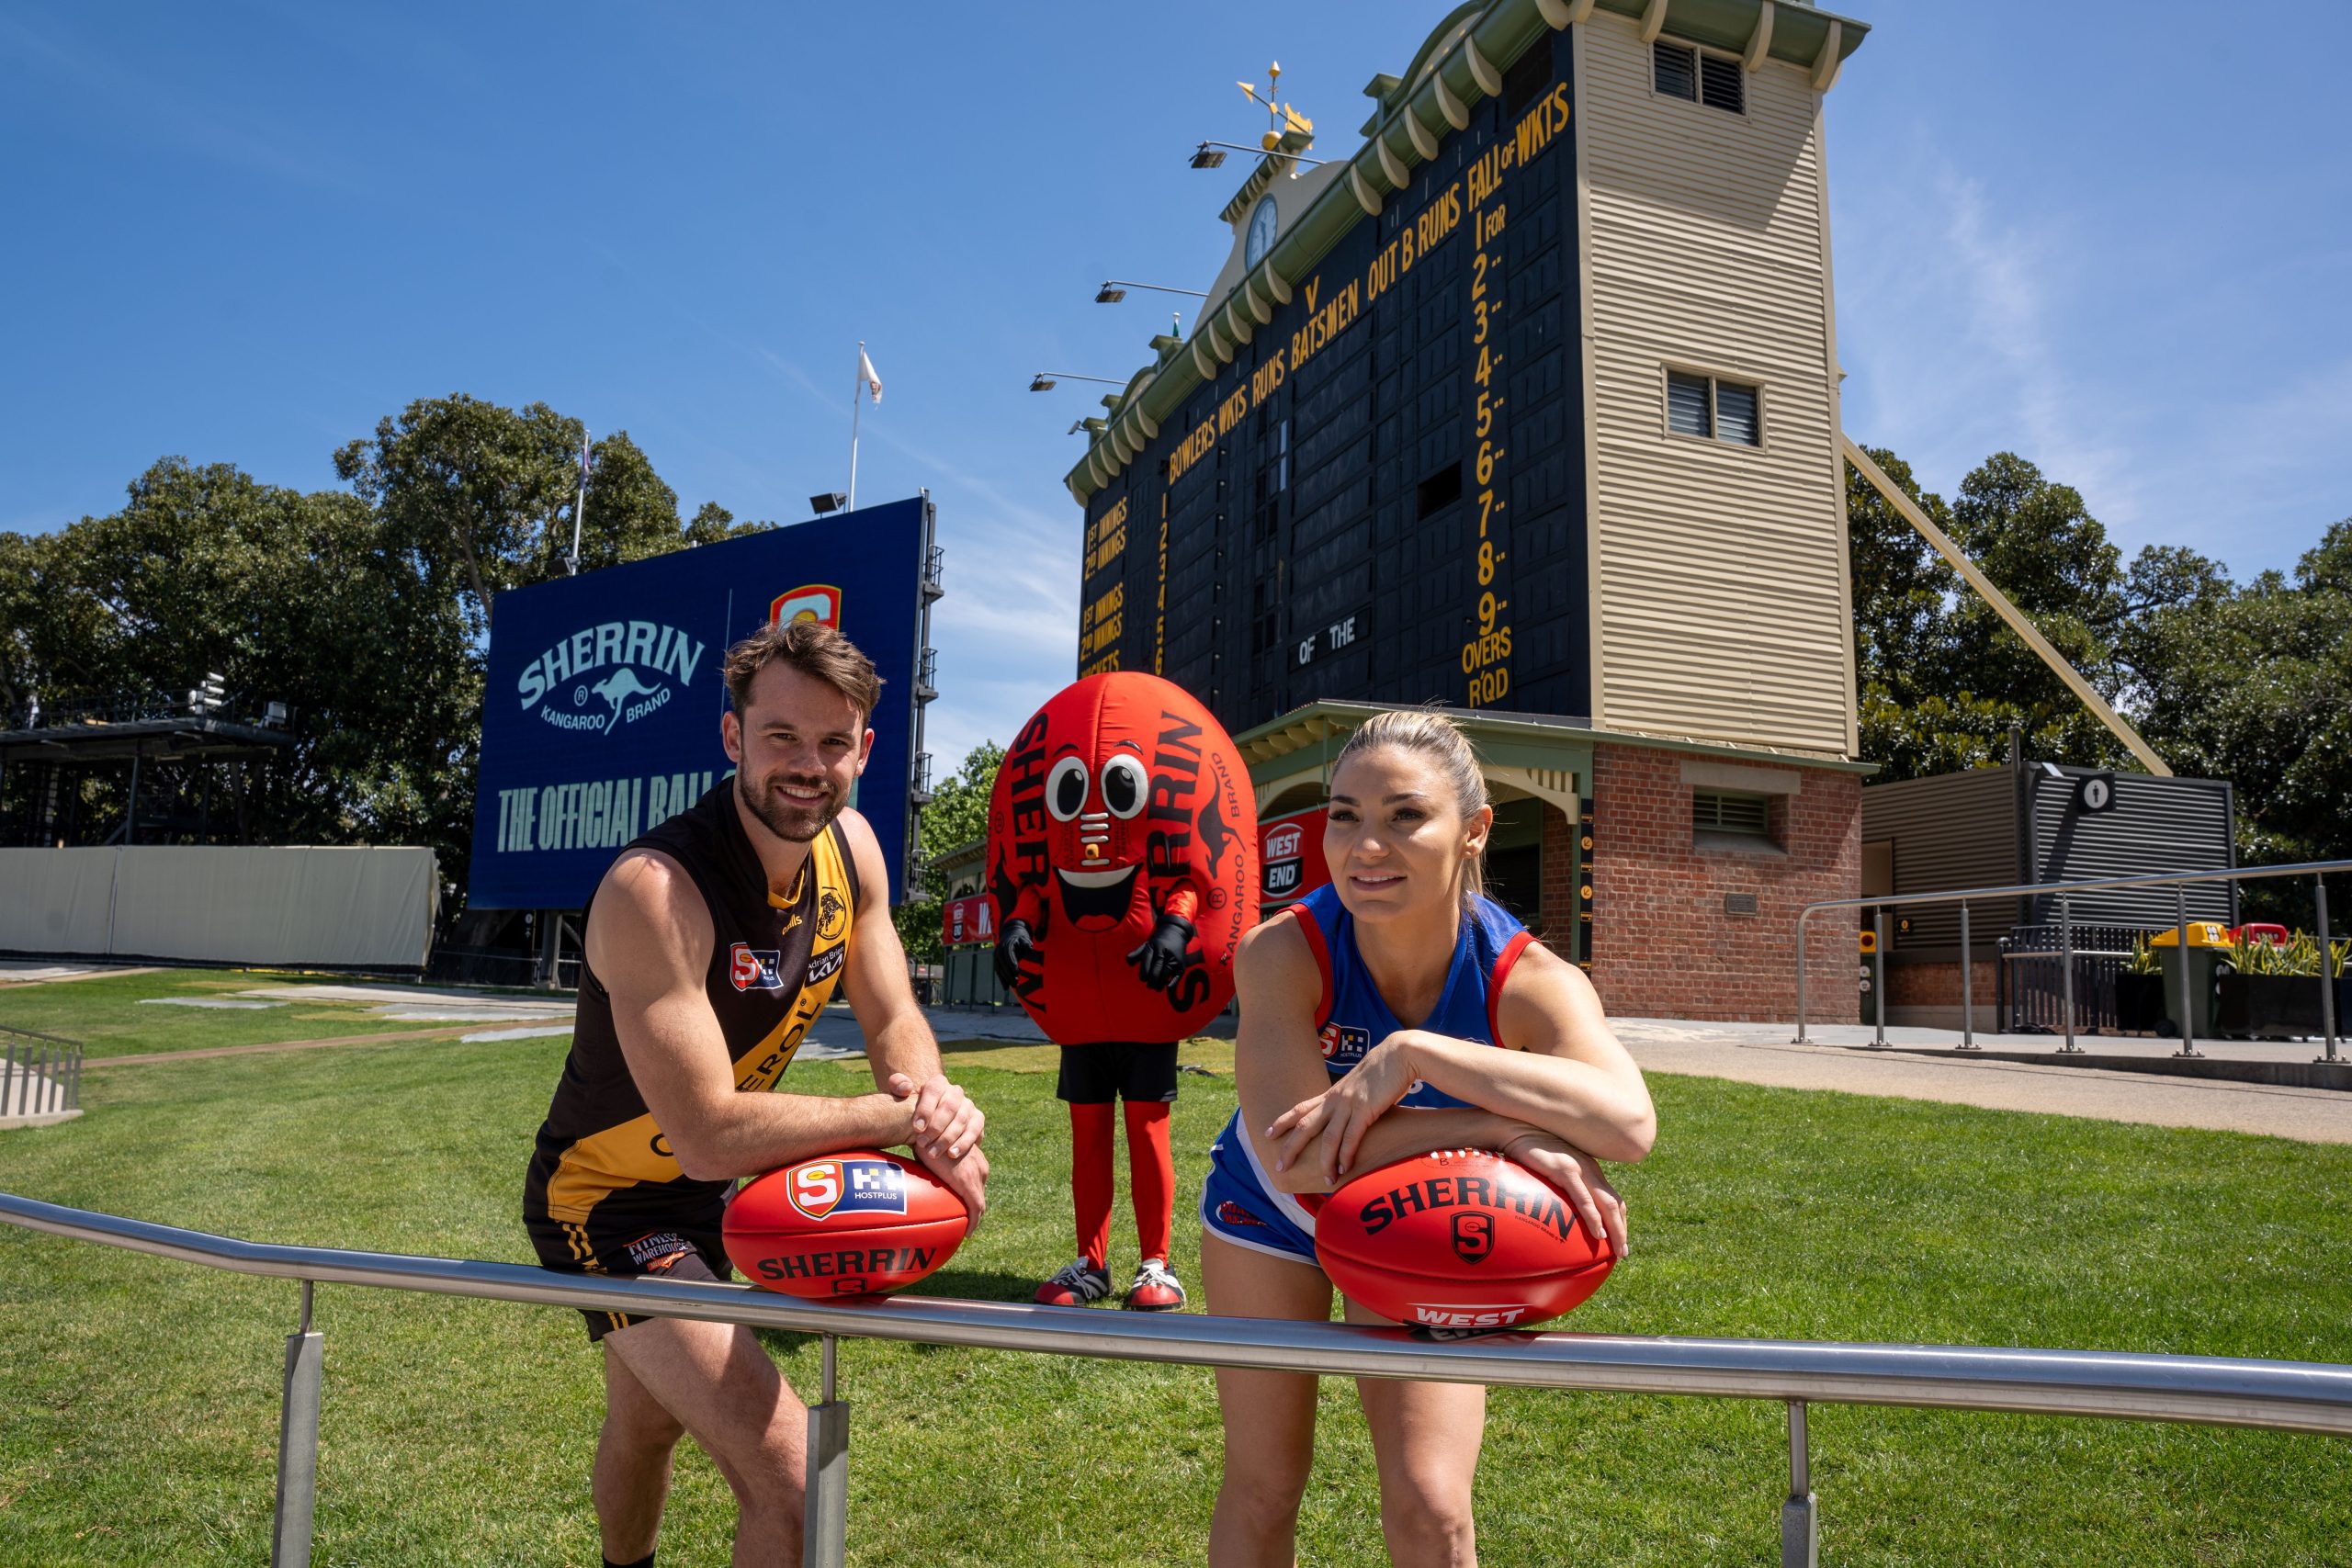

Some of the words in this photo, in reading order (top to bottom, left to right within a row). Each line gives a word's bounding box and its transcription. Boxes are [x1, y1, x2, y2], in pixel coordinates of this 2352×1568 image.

[1486, 204, 1506, 243] FOR
[1169, 414, 1216, 486] BOWLERS
[1218, 384, 1247, 436] WKTS
[1252, 348, 1284, 408] RUNS
[1291, 277, 1359, 372] BATSMEN
[1368, 240, 1397, 301] OUT
[1402, 227, 1414, 273] B
[1418, 183, 1461, 258] RUNS
[1468, 143, 1502, 212] FALL
[1500, 139, 1515, 169] OF
[1515, 82, 1569, 168] WKTS
[1305, 275, 1319, 314] V
[1099, 496, 1127, 543] INNINGS
[1159, 522, 1168, 552] 2
[1098, 525, 1125, 570] INNINGS
[1158, 553, 1167, 581] 3
[1095, 581, 1123, 626] INNINGS
[1157, 583, 1165, 611] 4
[1093, 612, 1122, 654] INNINGS
[1156, 615, 1164, 645] 5
[1299, 636, 1316, 664] OF
[1329, 616, 1355, 649] THE
[1463, 626, 1511, 673] OVERS
[517, 620, 705, 710] SHERRIN
[1080, 649, 1120, 679] CKETS
[1155, 647, 1163, 676] 6
[541, 705, 605, 730] KANGAROO
[627, 688, 671, 723] BRAND
[1212, 752, 1240, 818] BRAND
[497, 787, 537, 852] THE
[539, 778, 641, 849] OFFICIAL
[1147, 710, 1210, 1012] SRRIN
[1266, 832, 1301, 859] WEST
[1269, 864, 1295, 888] END
[1219, 854, 1245, 965] KANGAROO
[808, 955, 829, 969] Adrian
[829, 946, 844, 960] Brien
[854, 1191, 898, 1200] HOSTPLUS
[1360, 1177, 1577, 1243] SHERRIN
[757, 1247, 936, 1280] SHERRIN
[1417, 1307, 1525, 1326] WEST
